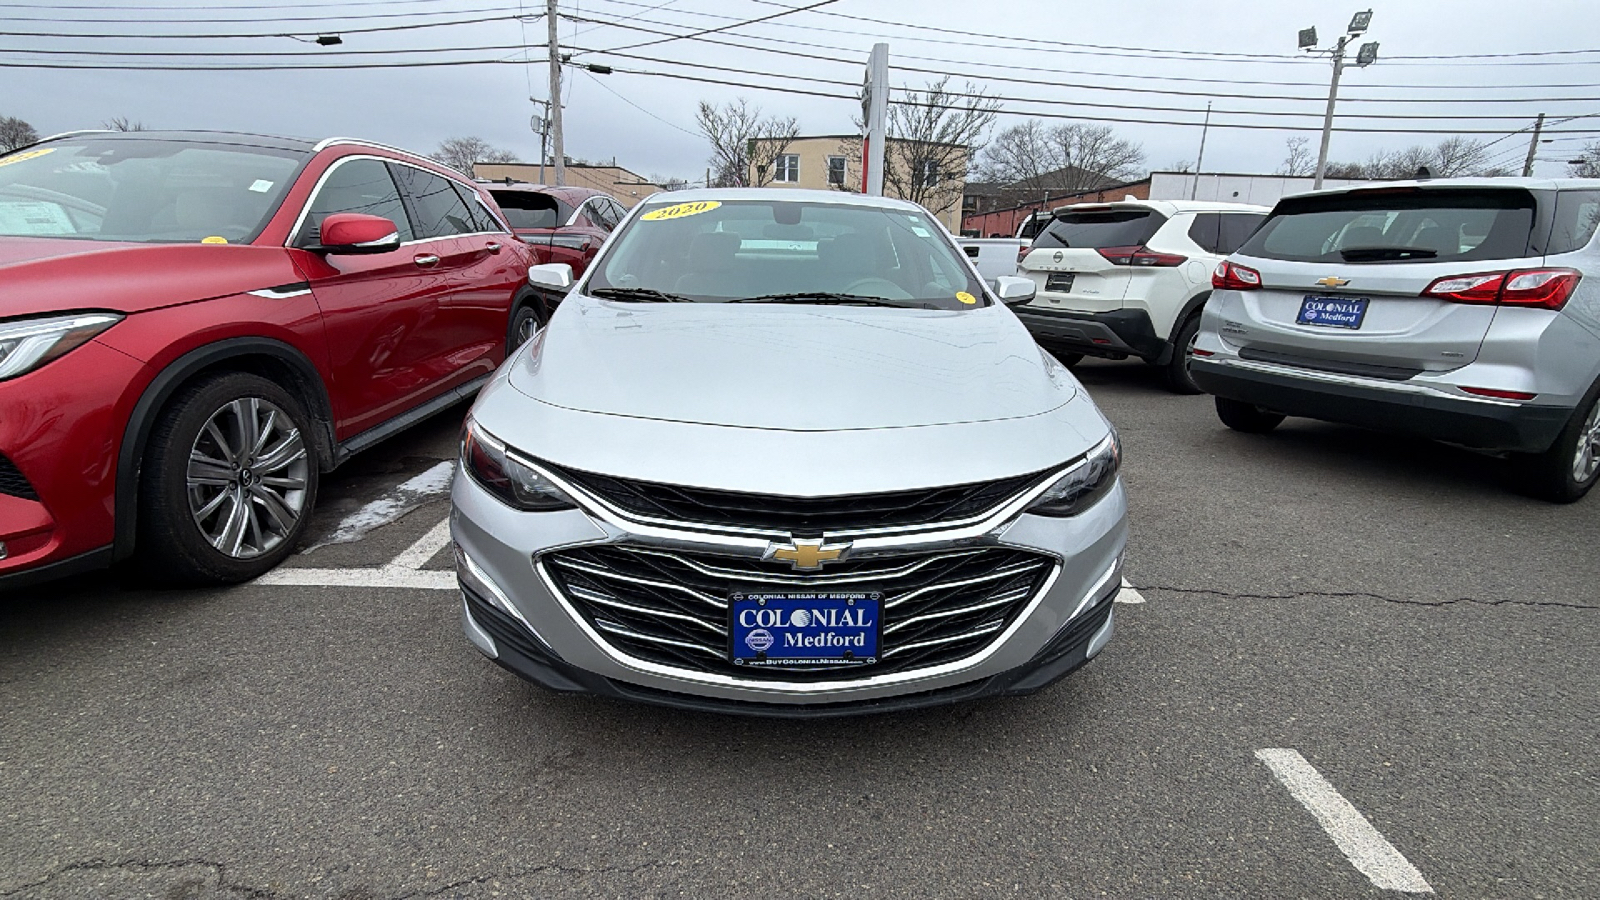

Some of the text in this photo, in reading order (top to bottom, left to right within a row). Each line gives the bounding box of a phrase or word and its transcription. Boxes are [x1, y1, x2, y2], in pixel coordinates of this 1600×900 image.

[656, 203, 707, 218] 2020
[1306, 301, 1360, 313] COLONIAL
[1320, 312, 1356, 323] Medford
[739, 609, 872, 627] COLONIAL
[783, 632, 865, 647] Medford
